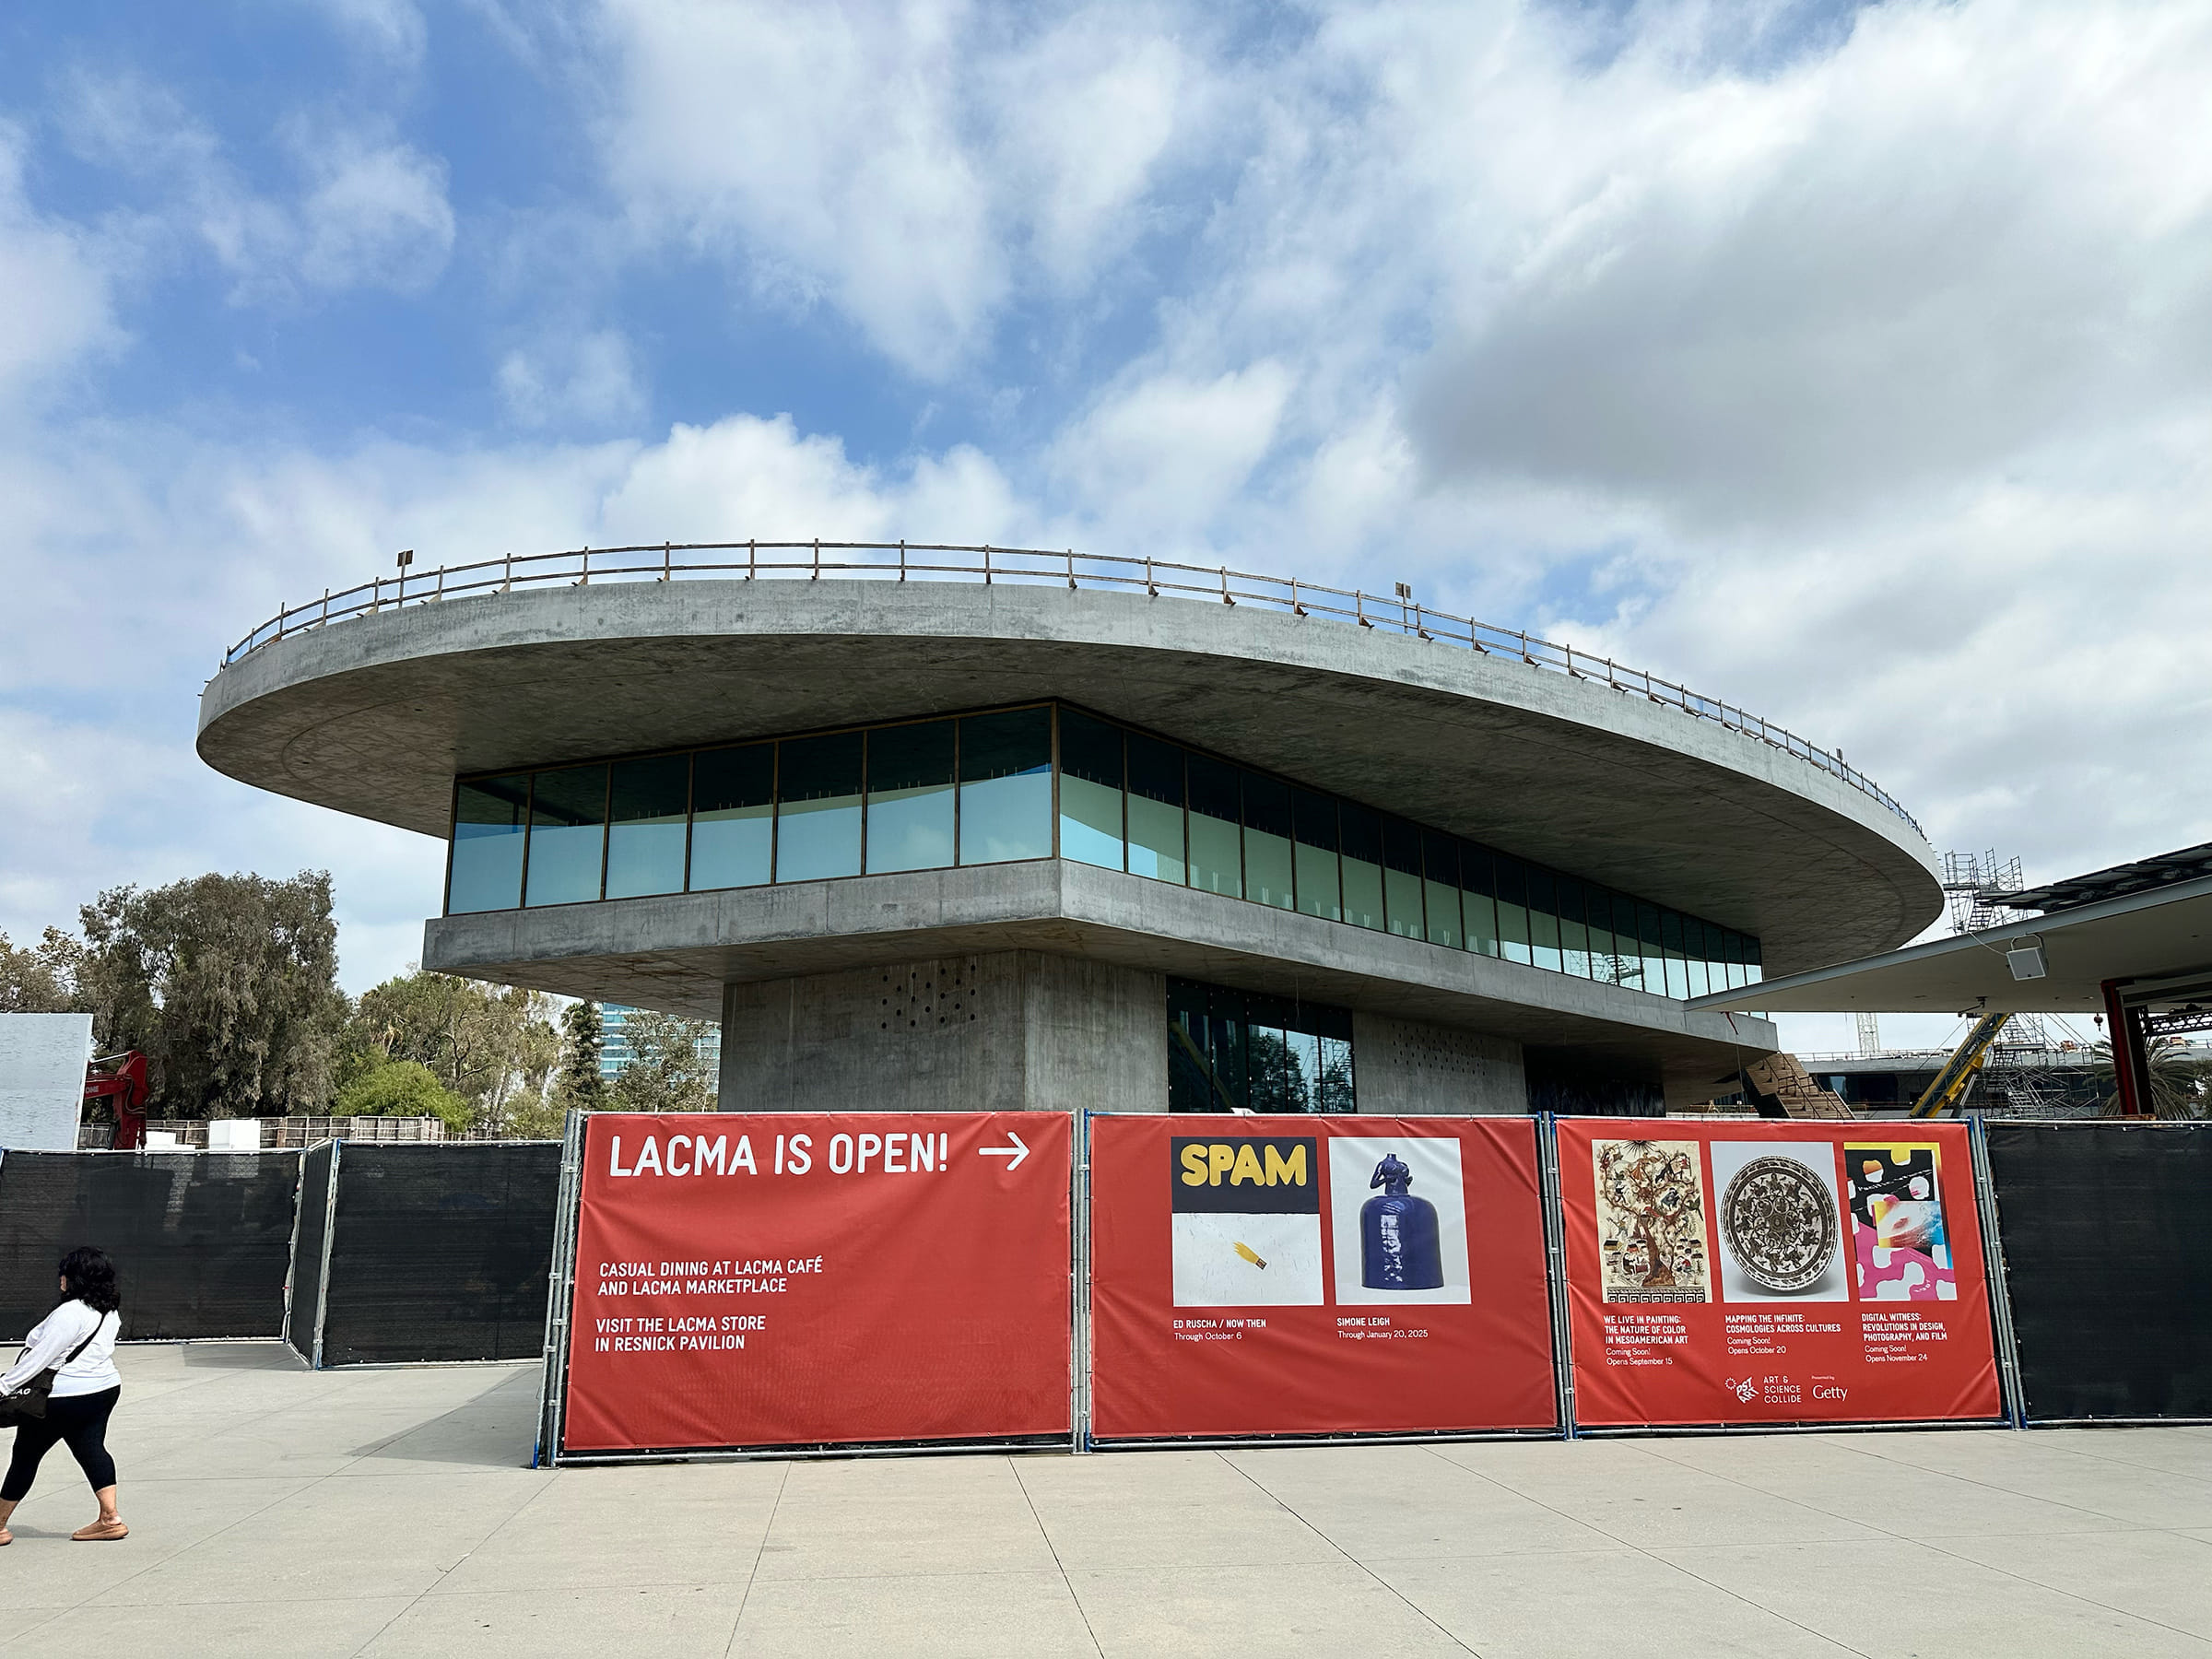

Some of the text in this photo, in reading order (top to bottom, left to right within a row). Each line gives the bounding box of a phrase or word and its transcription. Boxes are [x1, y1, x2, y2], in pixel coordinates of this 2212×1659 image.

[610, 1133, 948, 1176] LACMA IS OPEN!
[1181, 1144, 1307, 1187] SPAM
[599, 1255, 823, 1277] CASUAL DINING AT LACMA CAFÉ
[597, 1278, 788, 1296] AND LACMA MARKETPLACE
[1336, 1317, 1390, 1326] SIMONE LEIGH
[1604, 1315, 1681, 1324] WE LIVE IN PAINTING:
[1725, 1314, 1805, 1323] MAPPING THE INFINITE:
[1862, 1312, 1922, 1322] DIGITAL WITNESS:
[596, 1316, 766, 1333] VISIT THE LACMA STORE
[1173, 1319, 1266, 1328] ED RUSCHA / NOW THEN
[1863, 1322, 1946, 1332] REVOLUTIONS IN DESIGN,
[1605, 1325, 1686, 1334] THE NATURE OF COLOR
[1725, 1324, 1841, 1334] COSMOLOGIES ACROSS CULTURES
[1174, 1332, 1242, 1342] Through October 6
[1337, 1330, 1429, 1340] Through January 20, 2025
[1606, 1335, 1688, 1344] IN MESOAMERICAN ART
[1864, 1332, 1947, 1342] PHOTOGRAPHY, AND FILM
[594, 1335, 746, 1352] IN RESNICK PAVILION
[1726, 1336, 1771, 1346] Coming Soon!
[1606, 1347, 1651, 1357] Coming Soon!
[1728, 1347, 1748, 1355] Opens
[1776, 1346, 1787, 1354] 20
[1865, 1346, 1888, 1354] Coming
[1606, 1358, 1628, 1366] Opens
[1630, 1358, 1664, 1366] September
[1865, 1355, 1886, 1363] Opens
[1887, 1354, 1917, 1362] November
[1736, 1376, 1752, 1396] PST
[1764, 1385, 1801, 1394] SCIENCE
[1738, 1386, 1759, 1404] ART
[1812, 1384, 1848, 1402] Getty
[1764, 1394, 1802, 1404] COLLIDE
